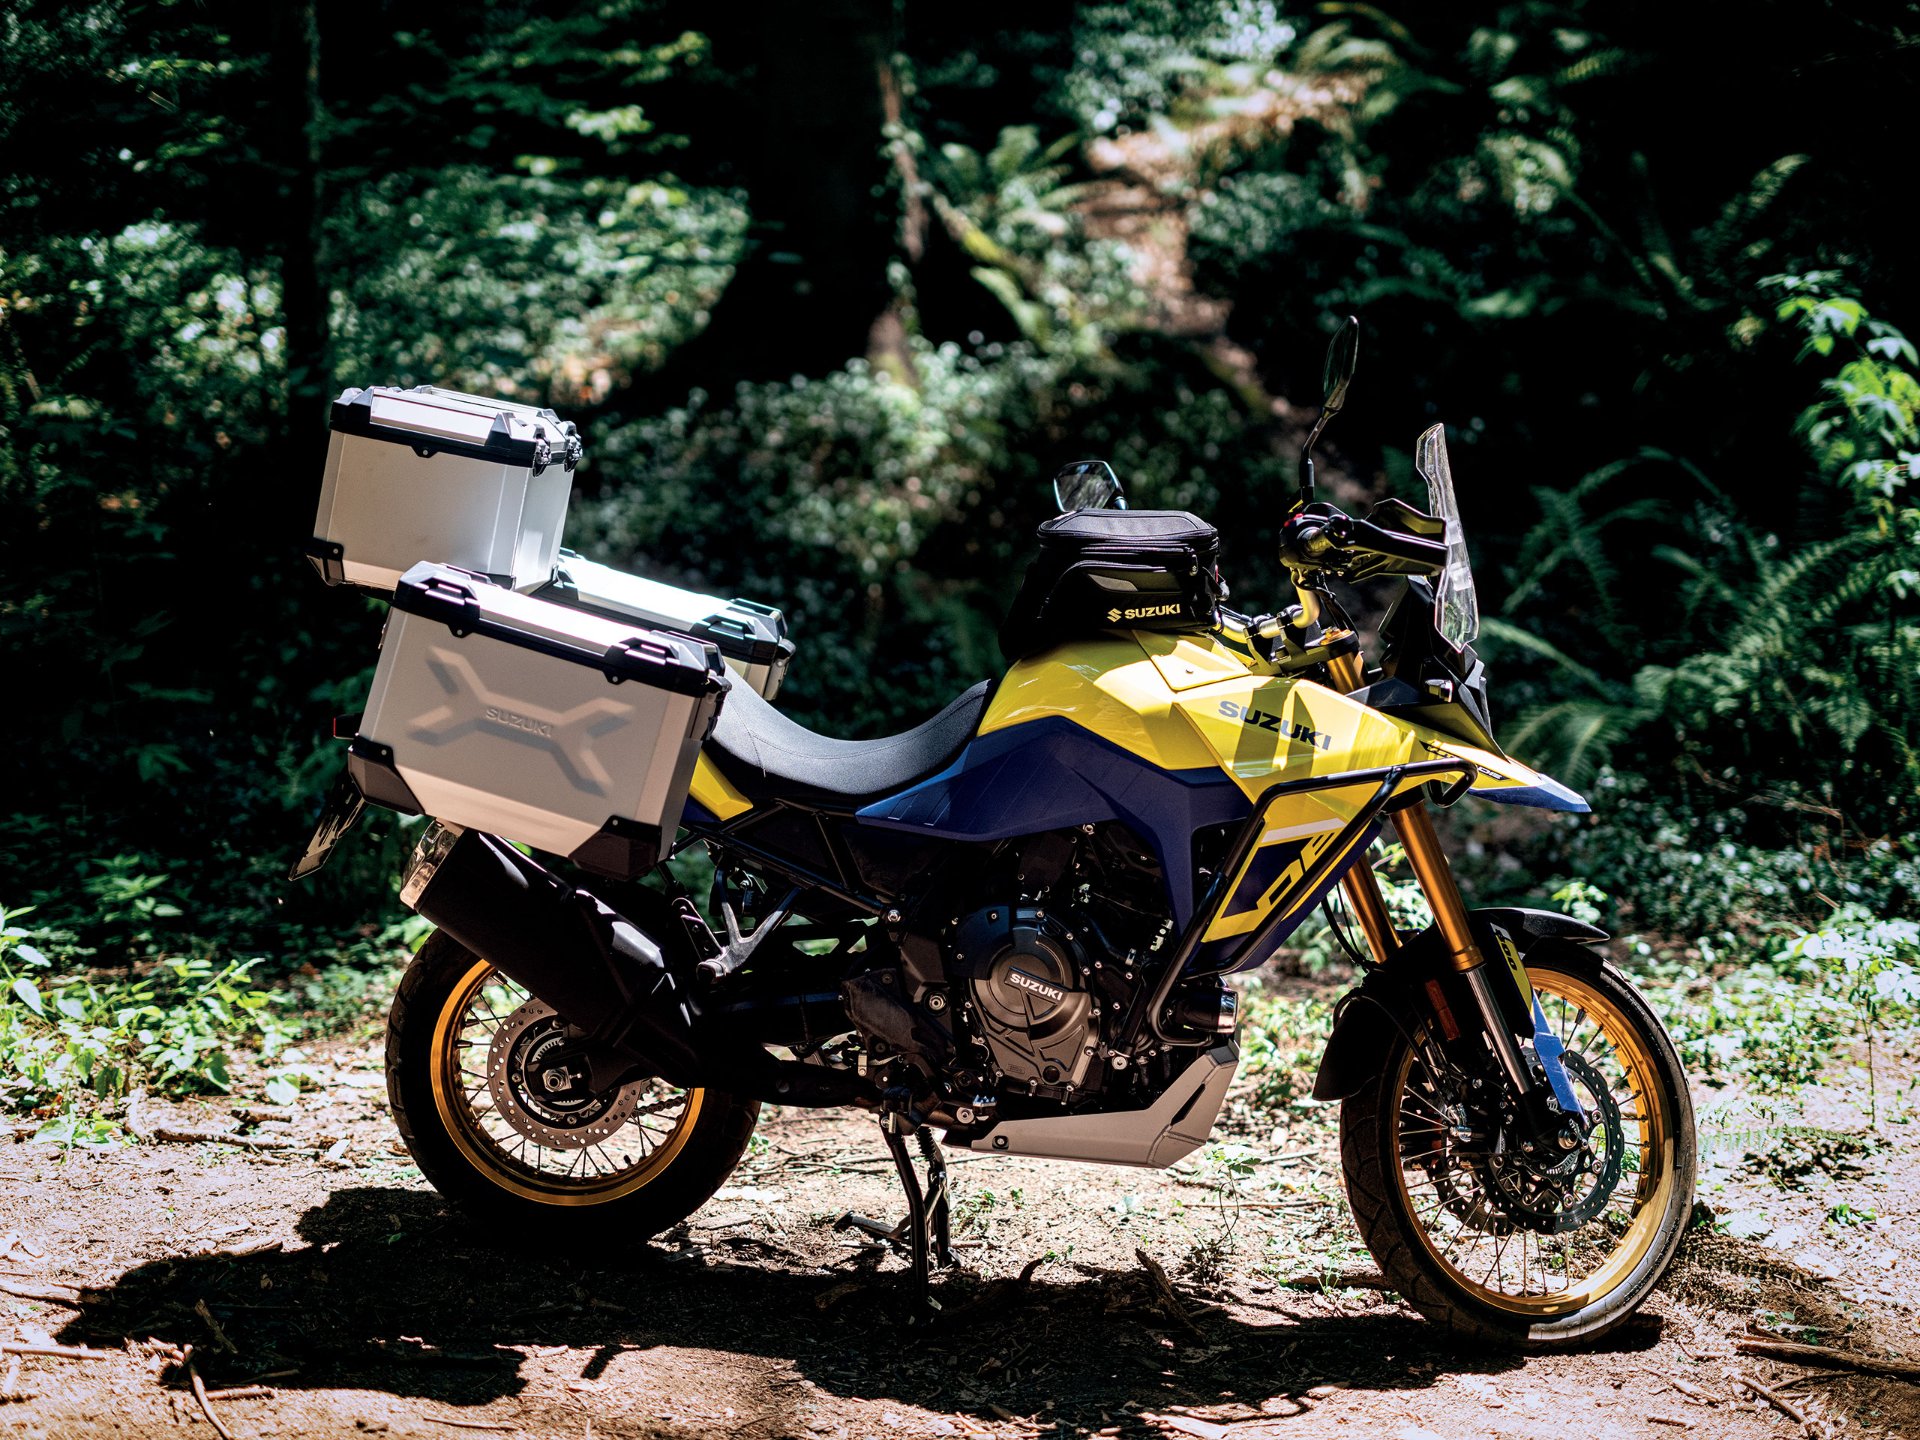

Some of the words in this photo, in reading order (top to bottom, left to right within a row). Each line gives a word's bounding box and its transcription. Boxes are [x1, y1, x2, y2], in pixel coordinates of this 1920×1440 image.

[1124, 603, 1180, 619] SUZUKI
[485, 708, 553, 738] SUZUKI
[1218, 700, 1332, 751] SUZUKI
[1009, 973, 1063, 1001] SUZUKI
